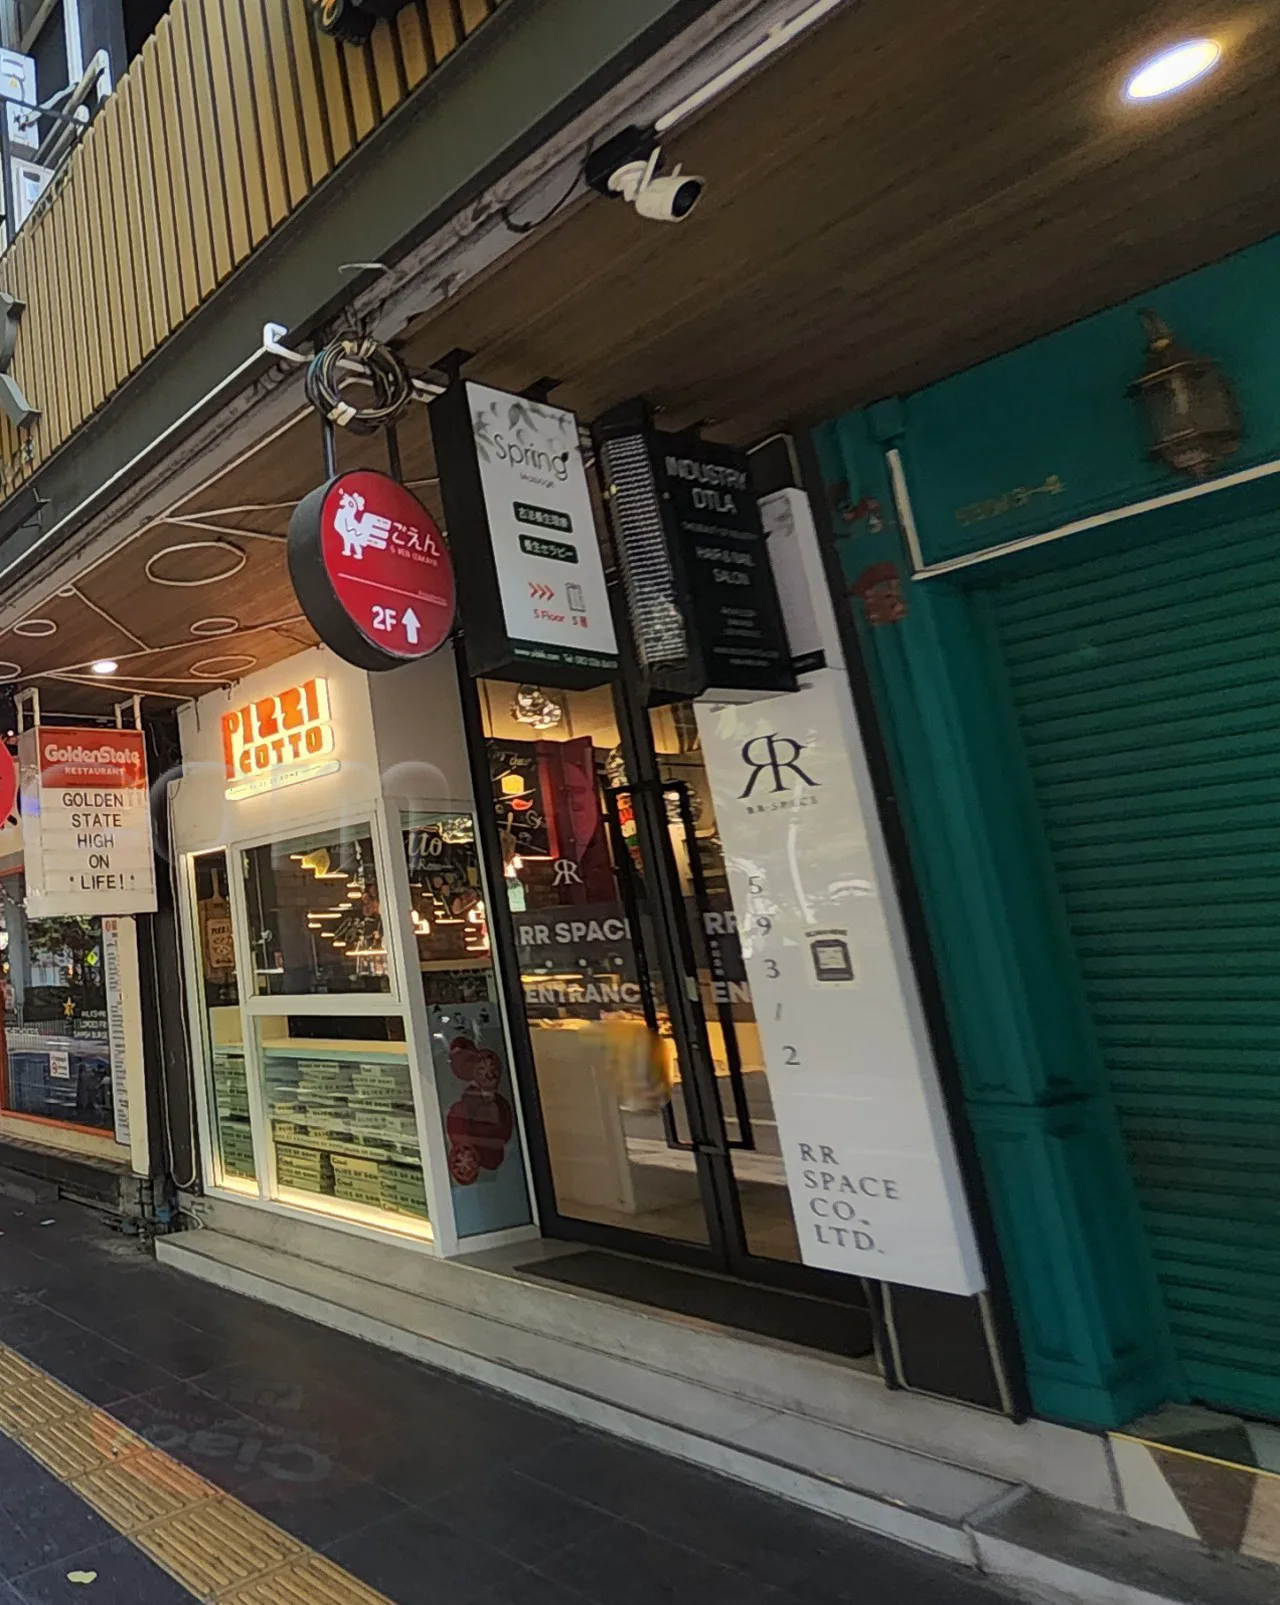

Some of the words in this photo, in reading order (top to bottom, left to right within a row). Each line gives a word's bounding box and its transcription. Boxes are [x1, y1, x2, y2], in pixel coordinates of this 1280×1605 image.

[494, 433, 569, 481] Spring
[391, 521, 441, 557] ごえん
[371, 605, 397, 632] 2F
[240, 726, 323, 775] COTTO
[64, 766, 125, 776] RESTAURANT
[62, 792, 124, 808] GOLDEN
[71, 813, 122, 828] STATE
[77, 833, 115, 849] HIGH
[88, 854, 110, 869] ON
[520, 926, 550, 946] RR
[798, 1142, 840, 1165] RR
[803, 1169, 901, 1200] SPACE
[814, 1223, 885, 1254] LTD.
